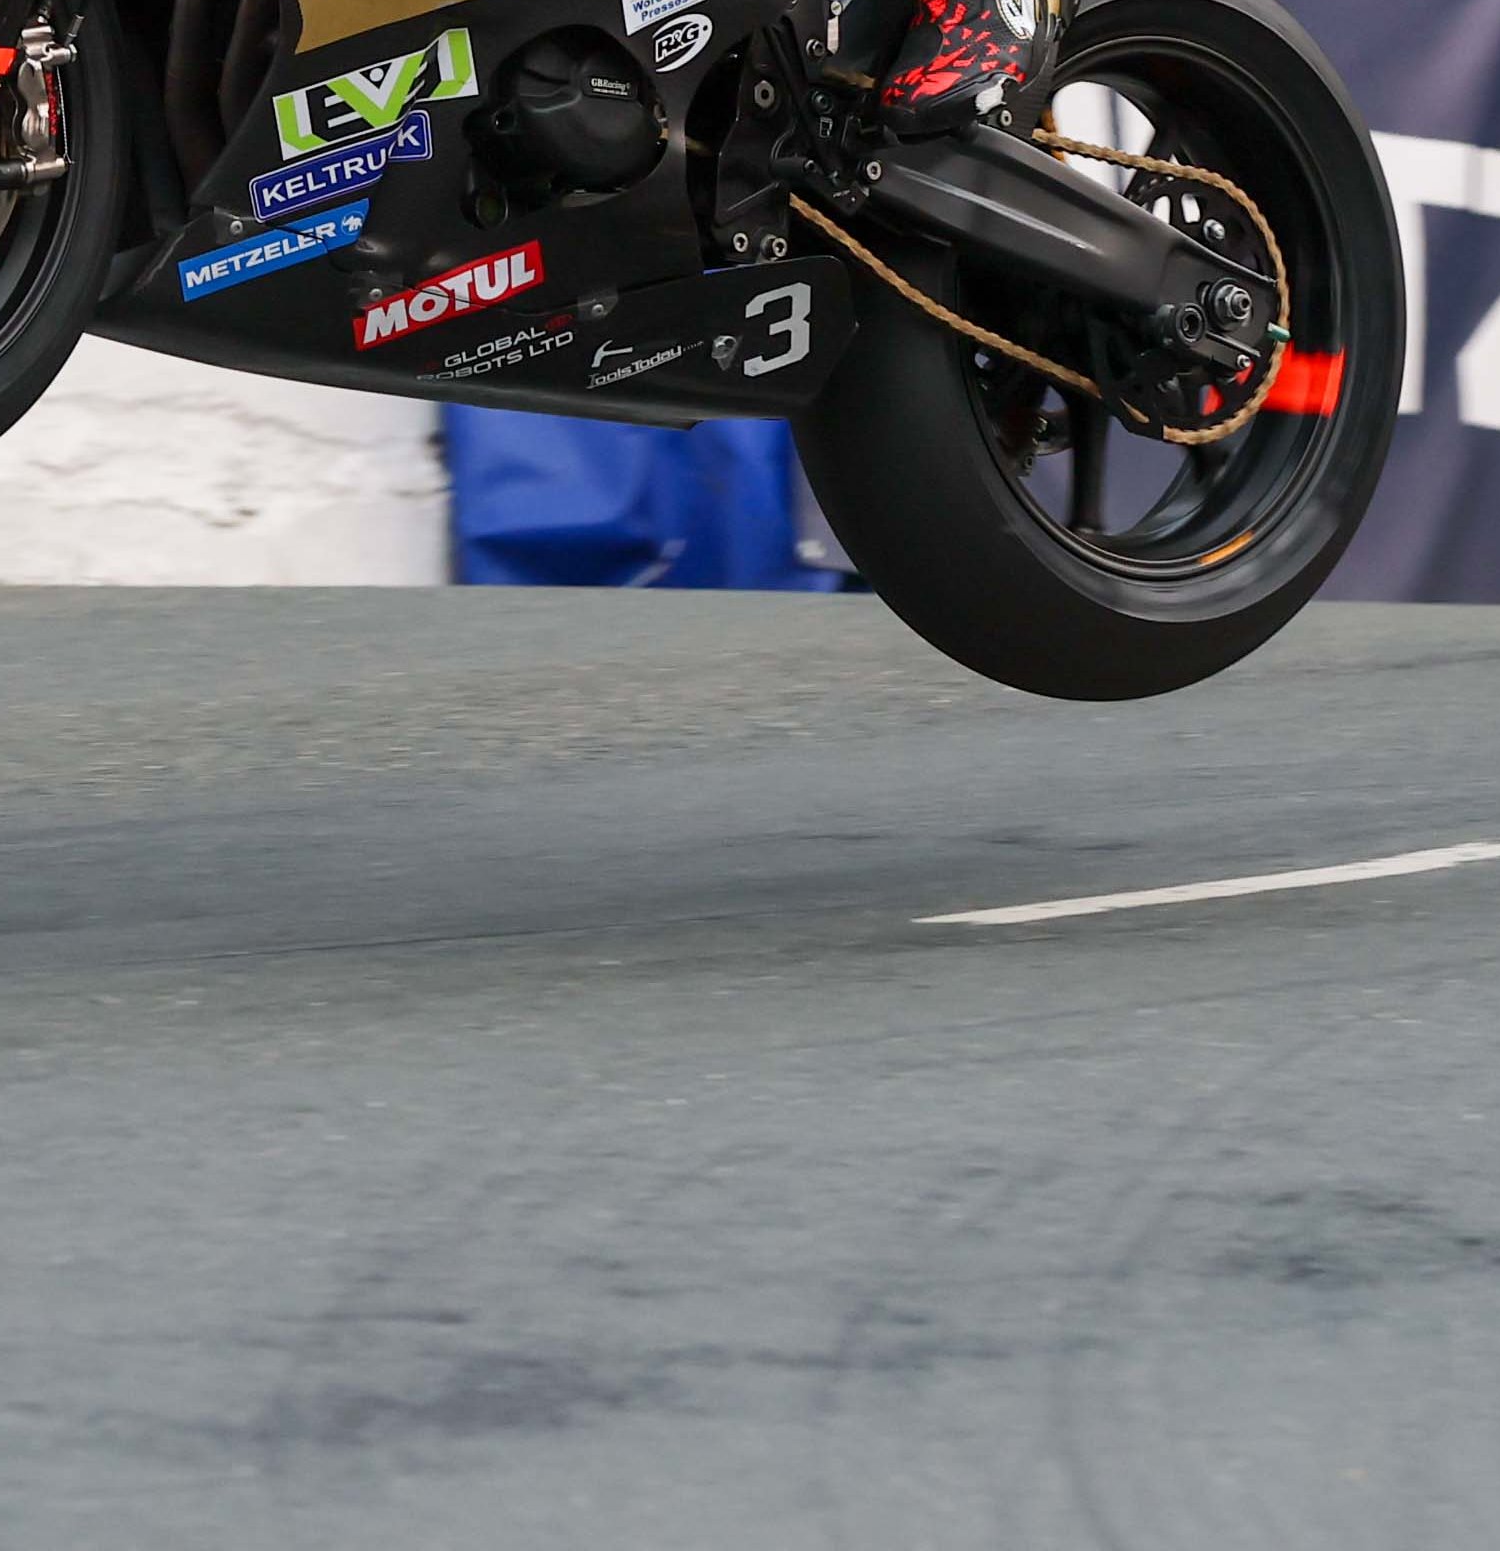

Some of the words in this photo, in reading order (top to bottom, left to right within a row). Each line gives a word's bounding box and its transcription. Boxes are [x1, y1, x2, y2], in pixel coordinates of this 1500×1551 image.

[655, 21, 701, 63] R&G
[261, 123, 421, 209] KELTRUK
[185, 220, 337, 289] METZELER
[362, 251, 536, 345] MOTUL
[743, 281, 811, 378] 3
[444, 326, 547, 369] GLOBAL
[528, 330, 574, 358] LTD
